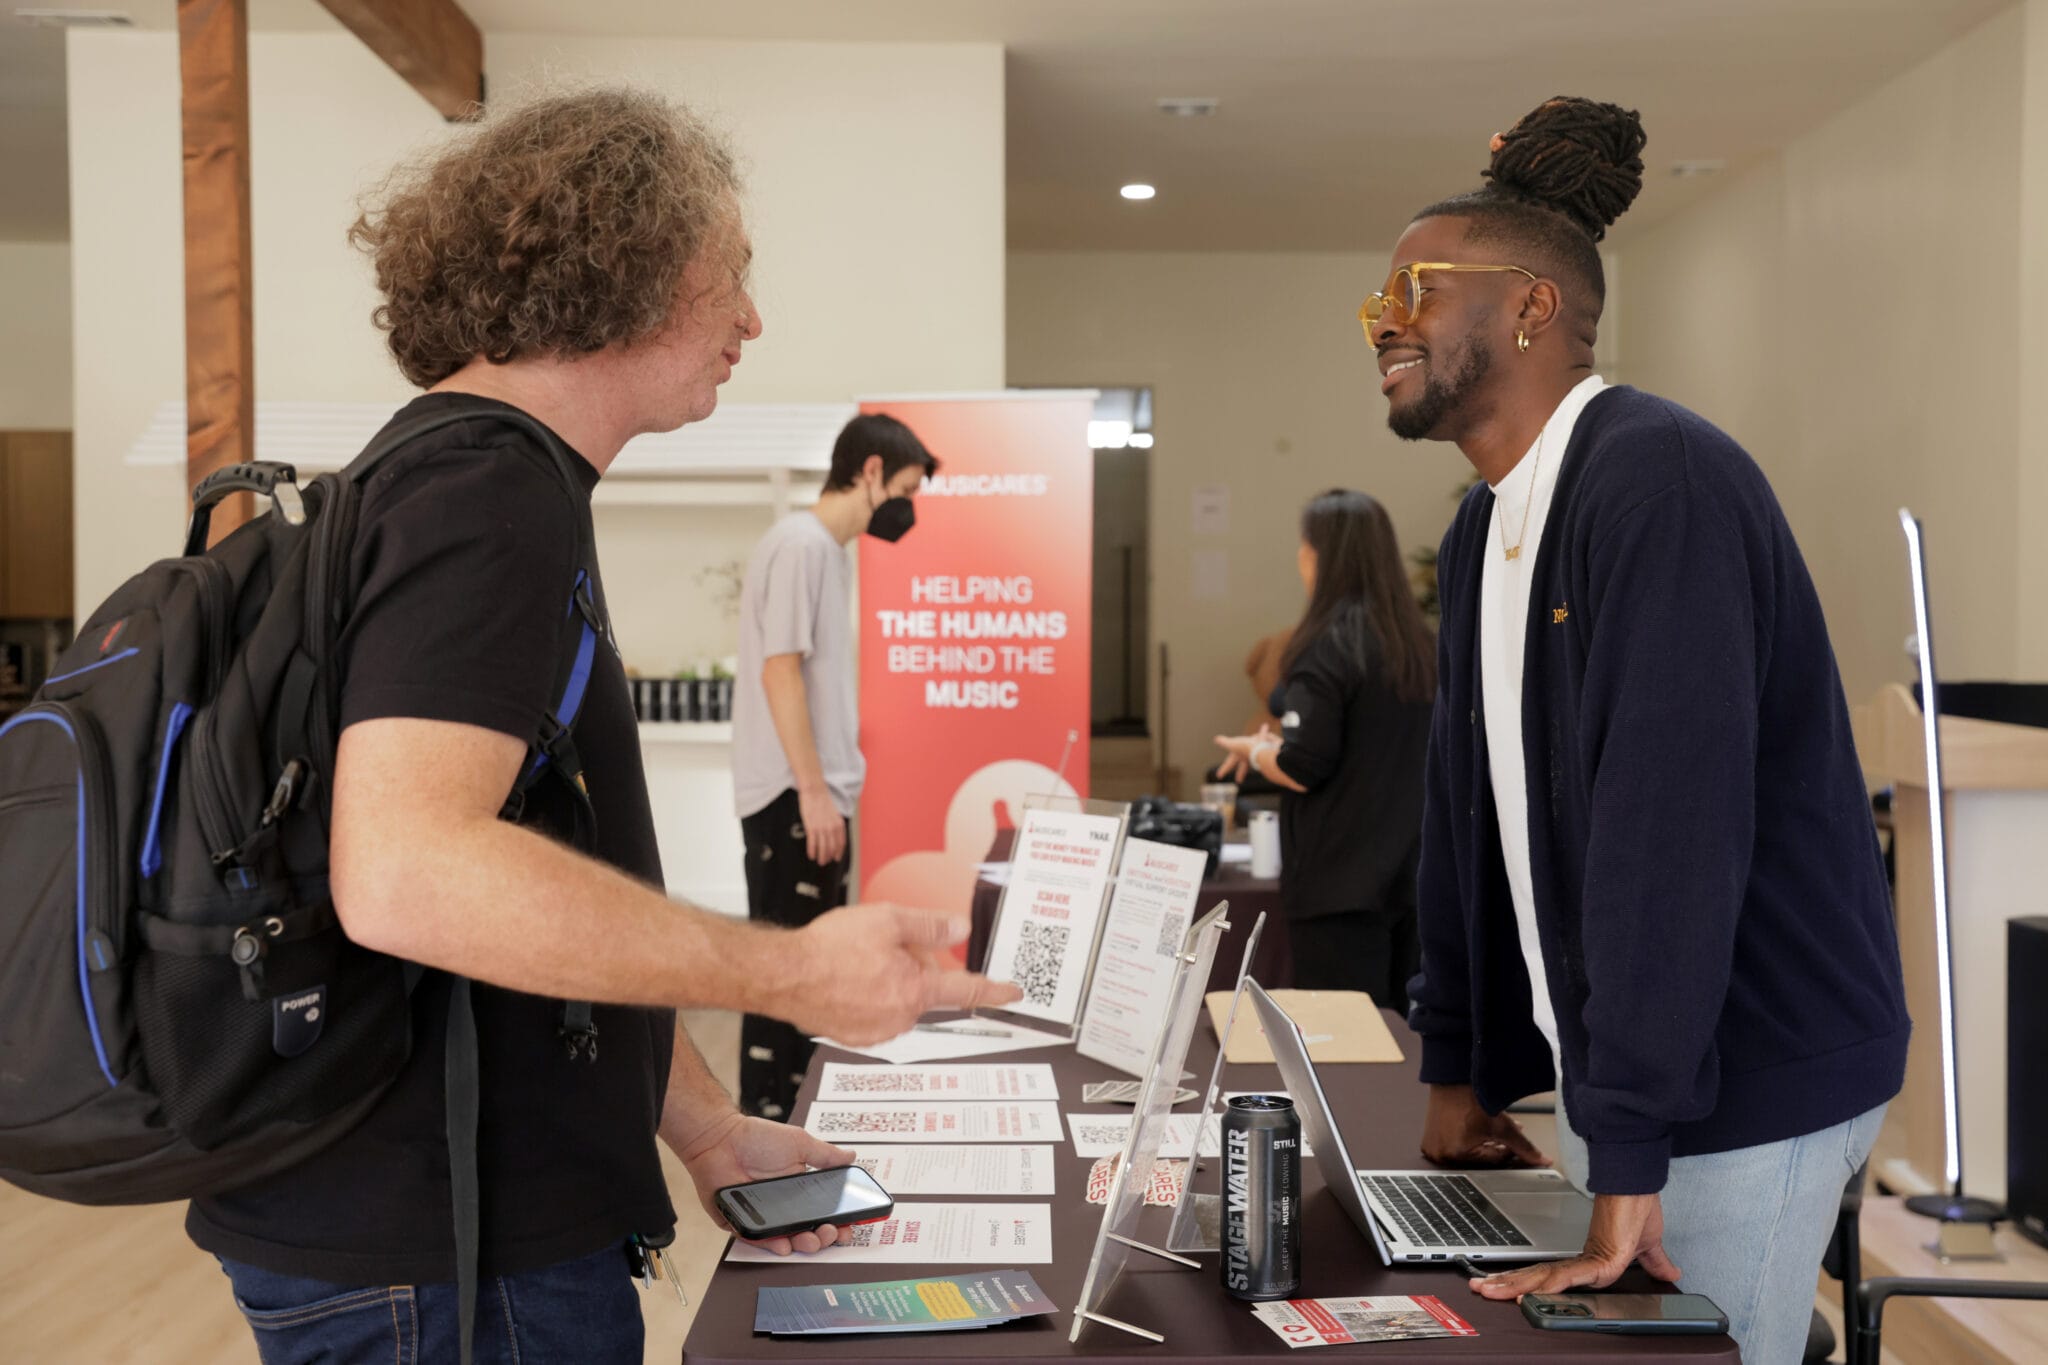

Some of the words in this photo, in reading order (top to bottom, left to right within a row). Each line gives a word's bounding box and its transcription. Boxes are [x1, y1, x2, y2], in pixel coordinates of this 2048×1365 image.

[911, 576, 1033, 605] HELPING
[876, 610, 936, 638] THE
[940, 611, 1067, 640] HUMANS
[888, 645, 996, 673] BEHIND
[1000, 647, 1055, 675] THE
[925, 680, 1019, 709] MUSIC
[281, 992, 320, 1012] POWER
[1273, 1138, 1296, 1150] STILL
[1282, 1153, 1290, 1194] FLOWING
[1228, 1128, 1249, 1291] STAGEWATER
[1282, 1196, 1290, 1226] MUSIC
[1281, 1228, 1289, 1245] THE
[1281, 1247, 1289, 1271] KEEP
